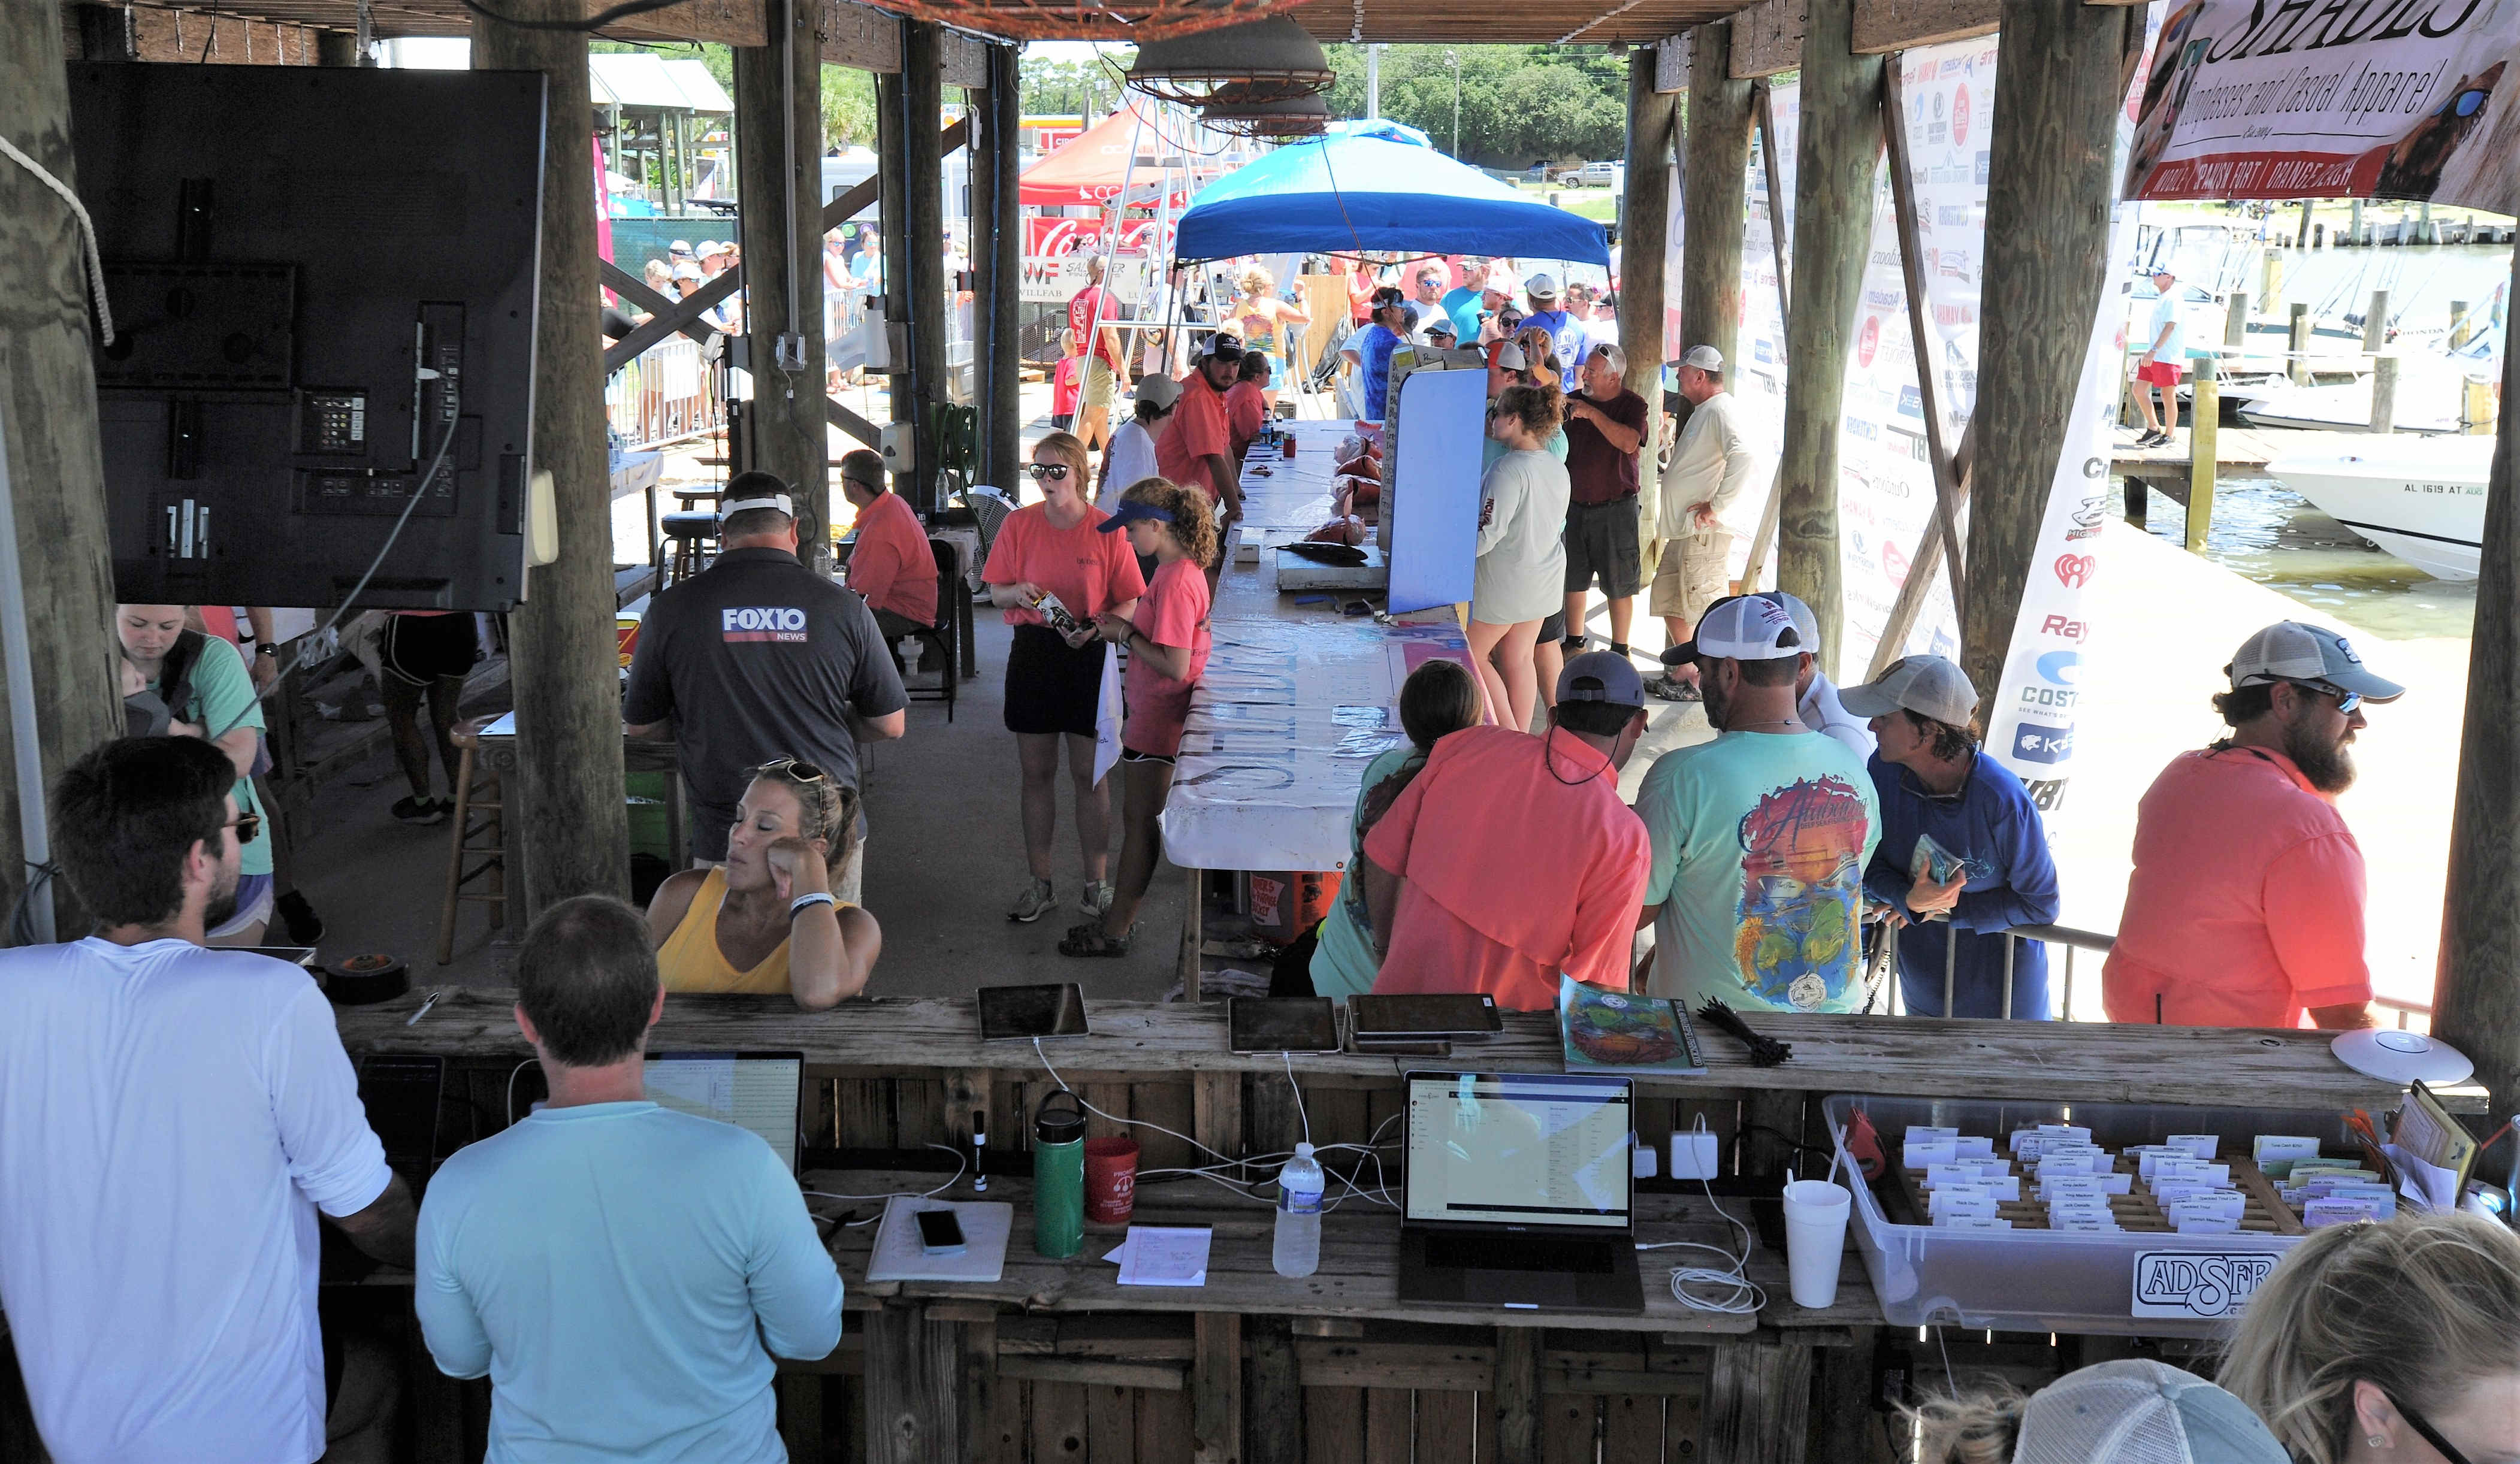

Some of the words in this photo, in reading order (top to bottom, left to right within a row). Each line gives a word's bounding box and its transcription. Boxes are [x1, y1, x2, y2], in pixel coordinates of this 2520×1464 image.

[2340, 59, 2449, 126] Apparel
[2234, 161, 2262, 190] FORT
[2404, 484, 2418, 492] AL
[2423, 485, 2444, 494] 1619
[2449, 486, 2462, 495] AT
[723, 608, 806, 631] FOX10
